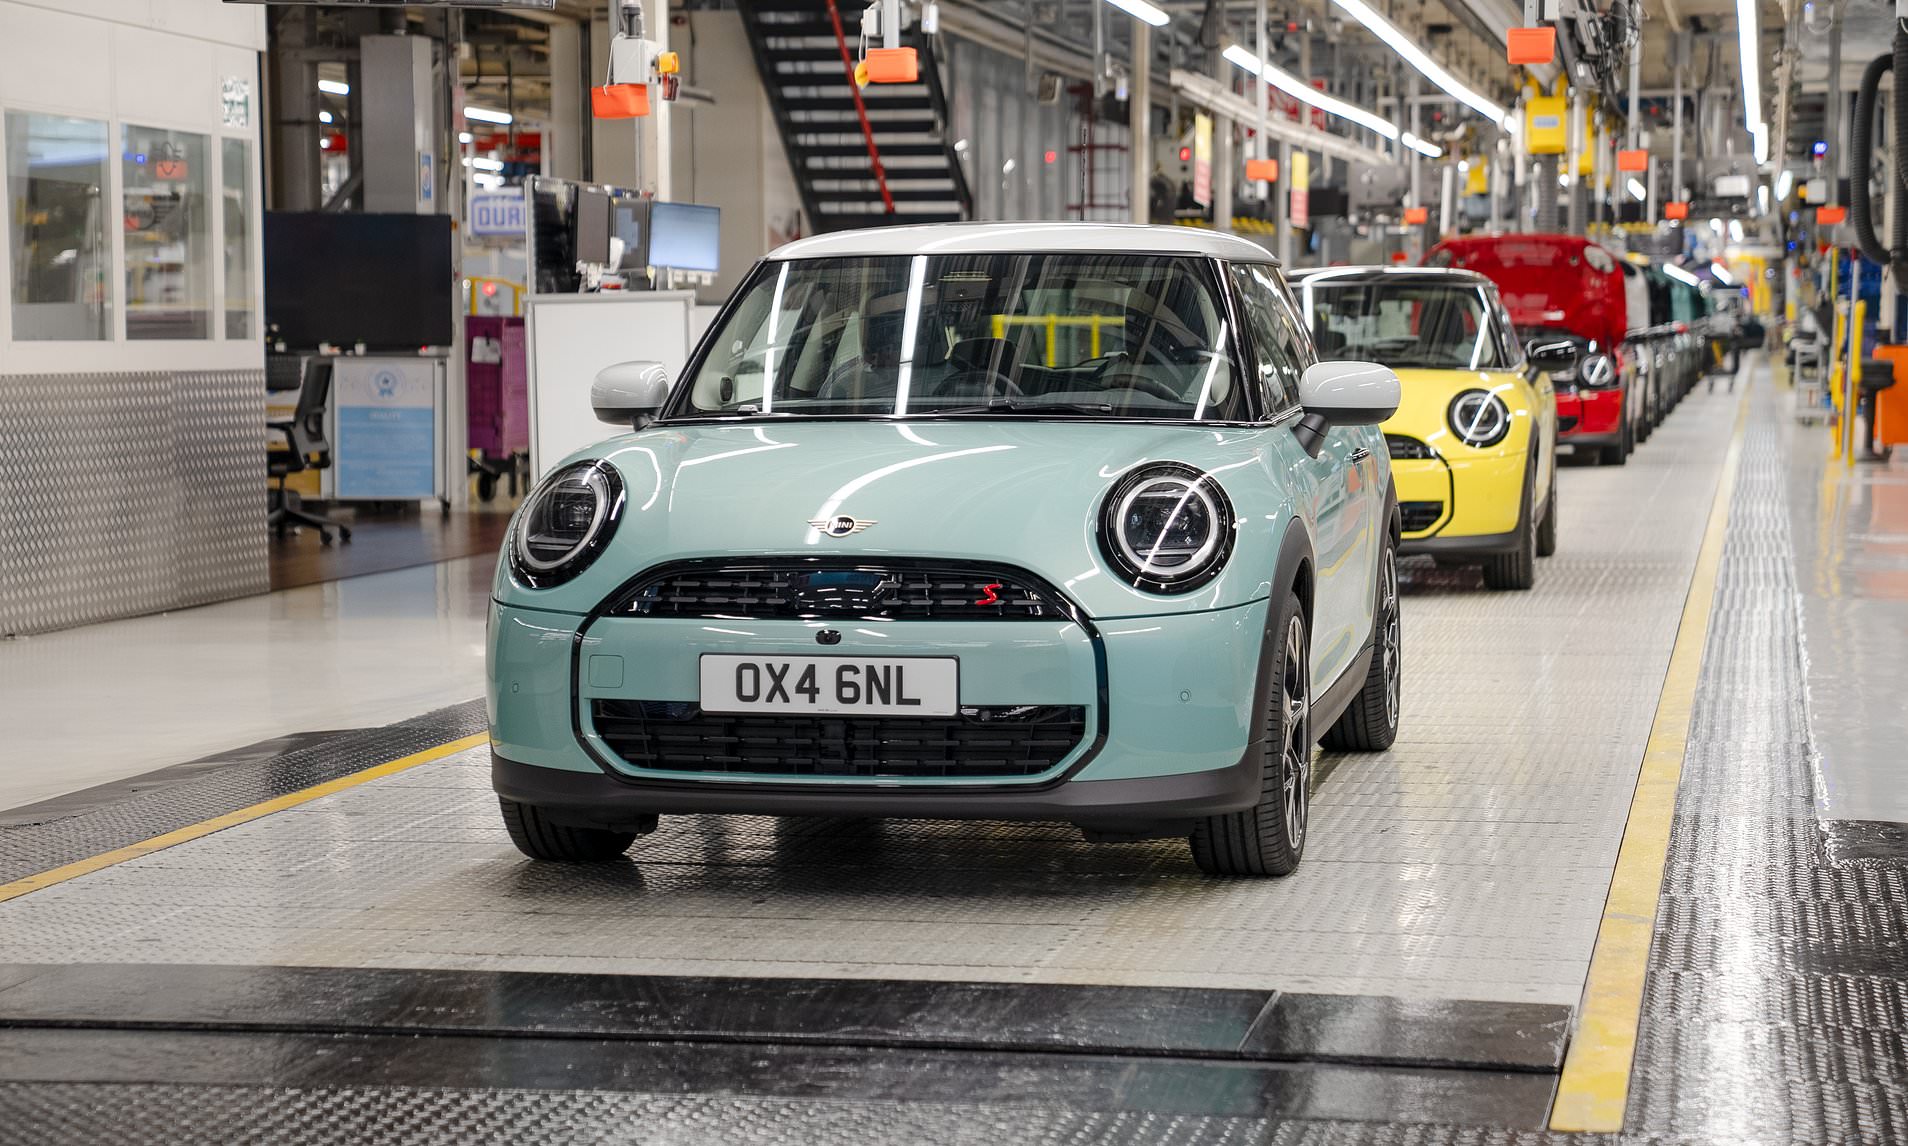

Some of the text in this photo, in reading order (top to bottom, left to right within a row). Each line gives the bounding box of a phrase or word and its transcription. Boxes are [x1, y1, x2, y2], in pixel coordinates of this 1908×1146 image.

[975, 583, 1003, 605] S
[735, 662, 921, 706] OX4 6NL
